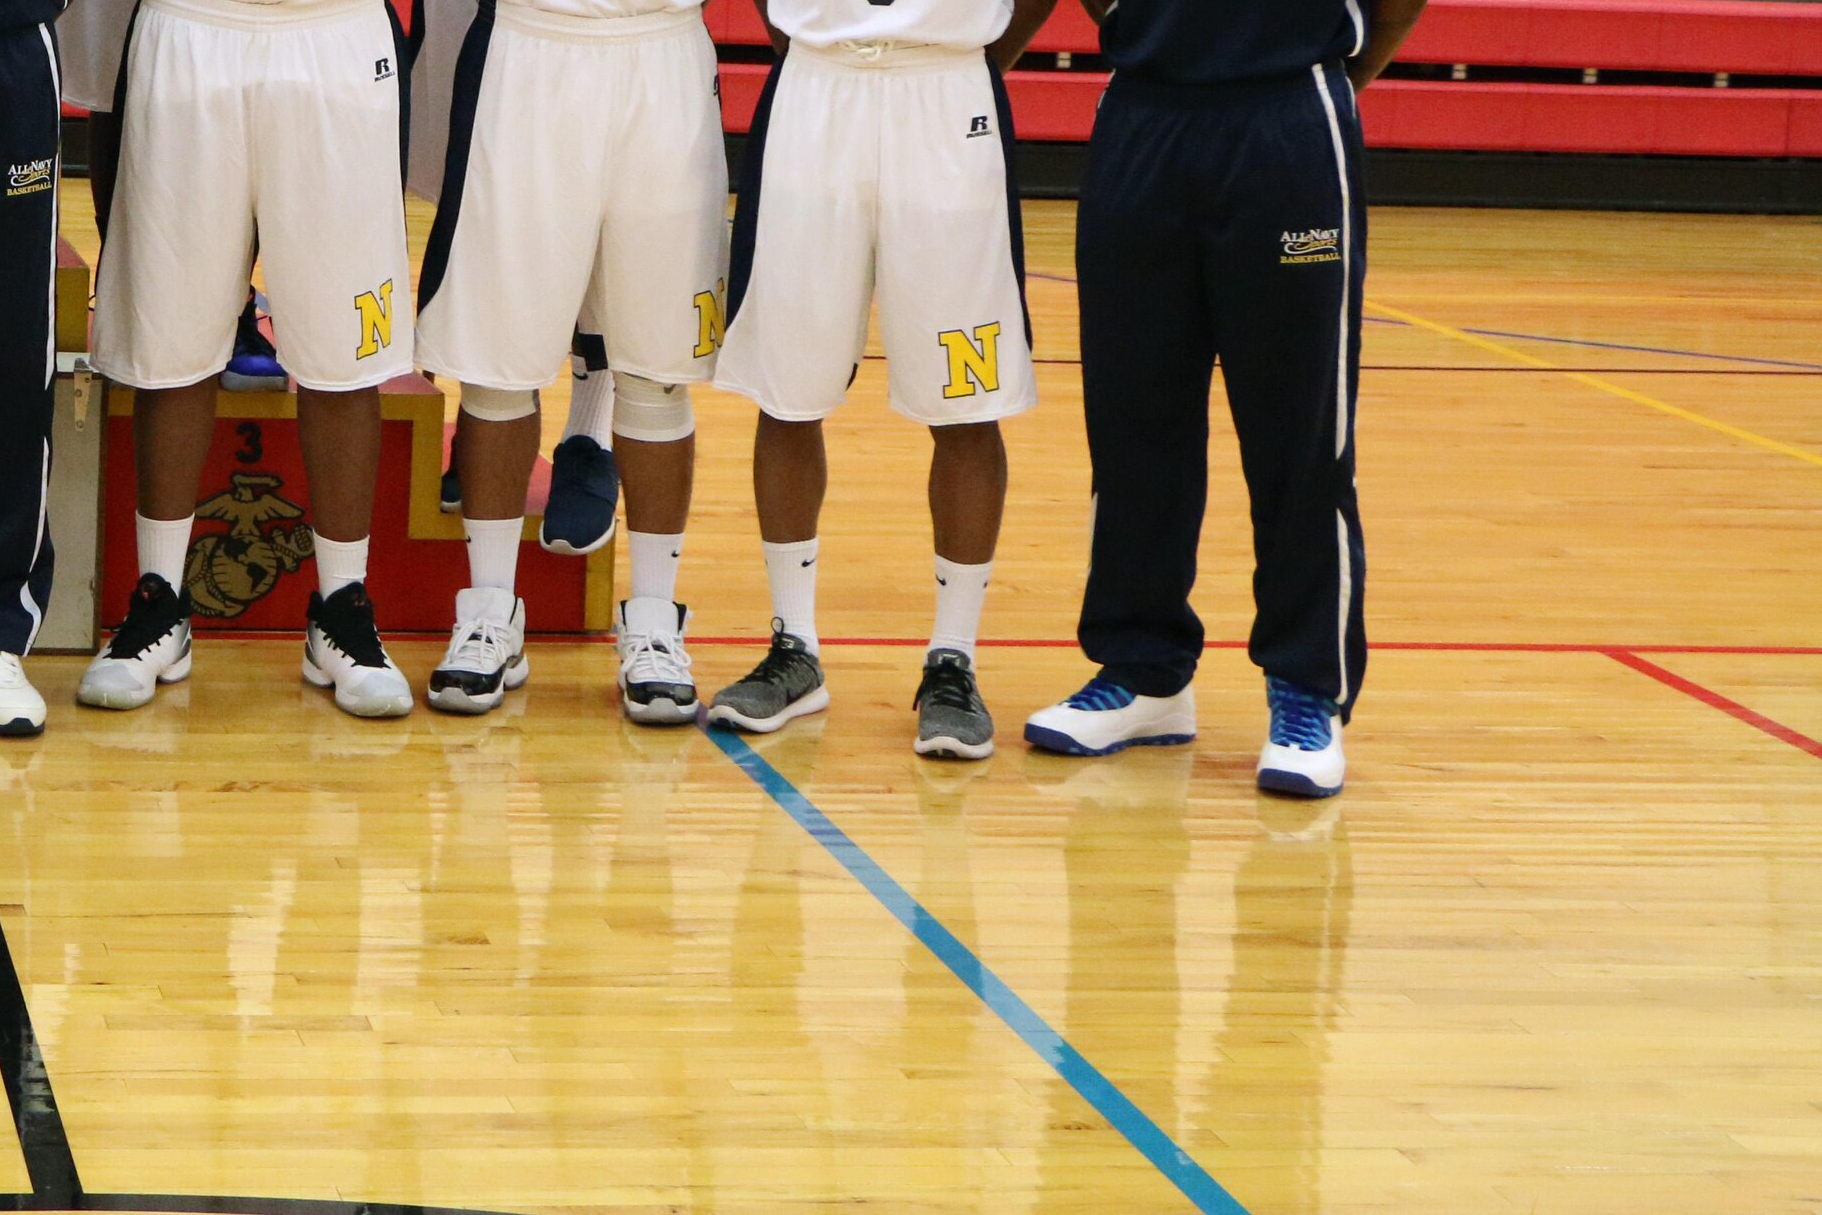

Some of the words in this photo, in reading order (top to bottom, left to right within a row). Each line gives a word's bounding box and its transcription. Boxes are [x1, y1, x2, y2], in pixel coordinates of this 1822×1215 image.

[7, 181, 52, 196] BASKETBALL
[1280, 252, 1341, 264] BASKETBALL
[354, 279, 393, 361] N
[693, 276, 725, 359] N
[938, 321, 1000, 399] N
[235, 422, 263, 464] 3
